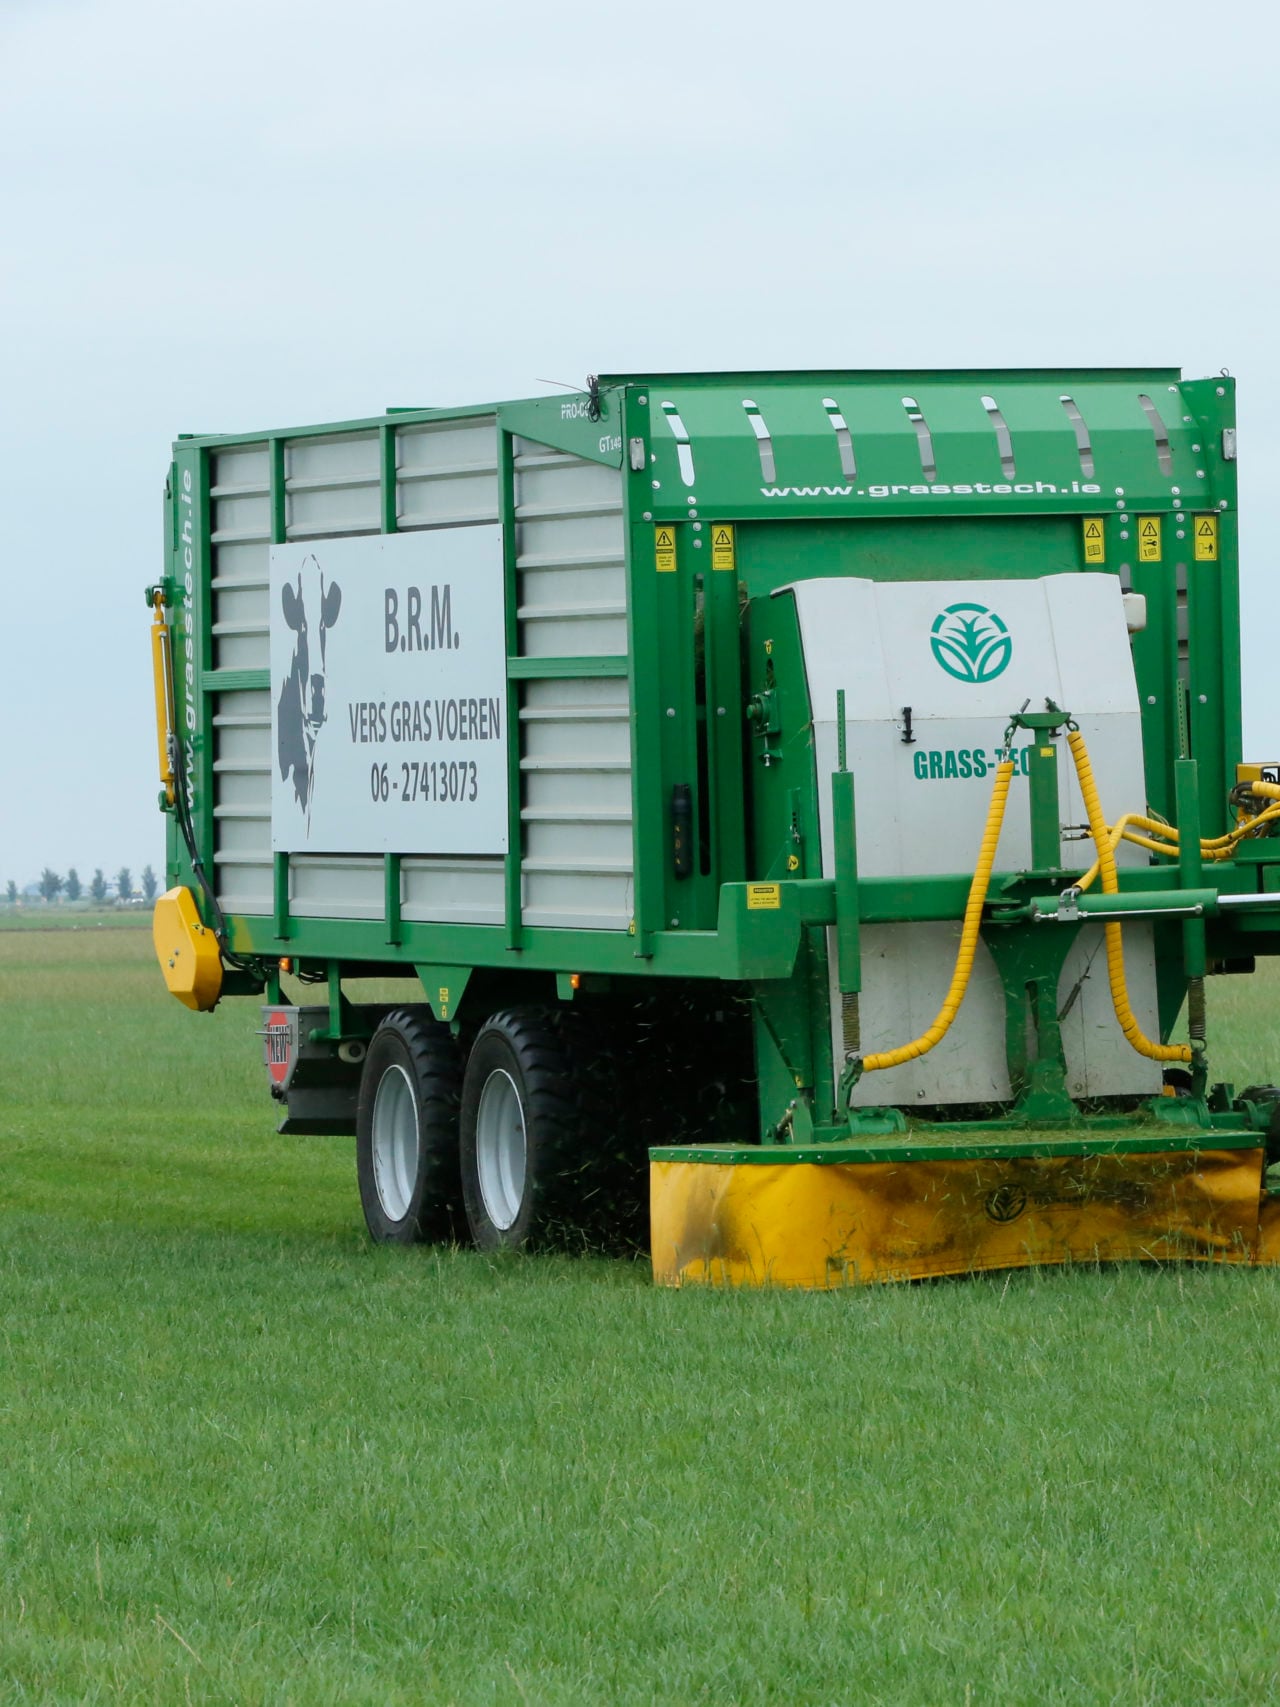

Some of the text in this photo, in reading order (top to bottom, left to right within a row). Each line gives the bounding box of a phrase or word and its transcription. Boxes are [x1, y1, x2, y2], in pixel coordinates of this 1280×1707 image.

[760, 481, 1101, 497] www.grasstech.ie
[385, 584, 460, 653] B.R.M.
[349, 697, 500, 743] VERS GRAS VOEREN
[401, 761, 478, 802] 27413073
